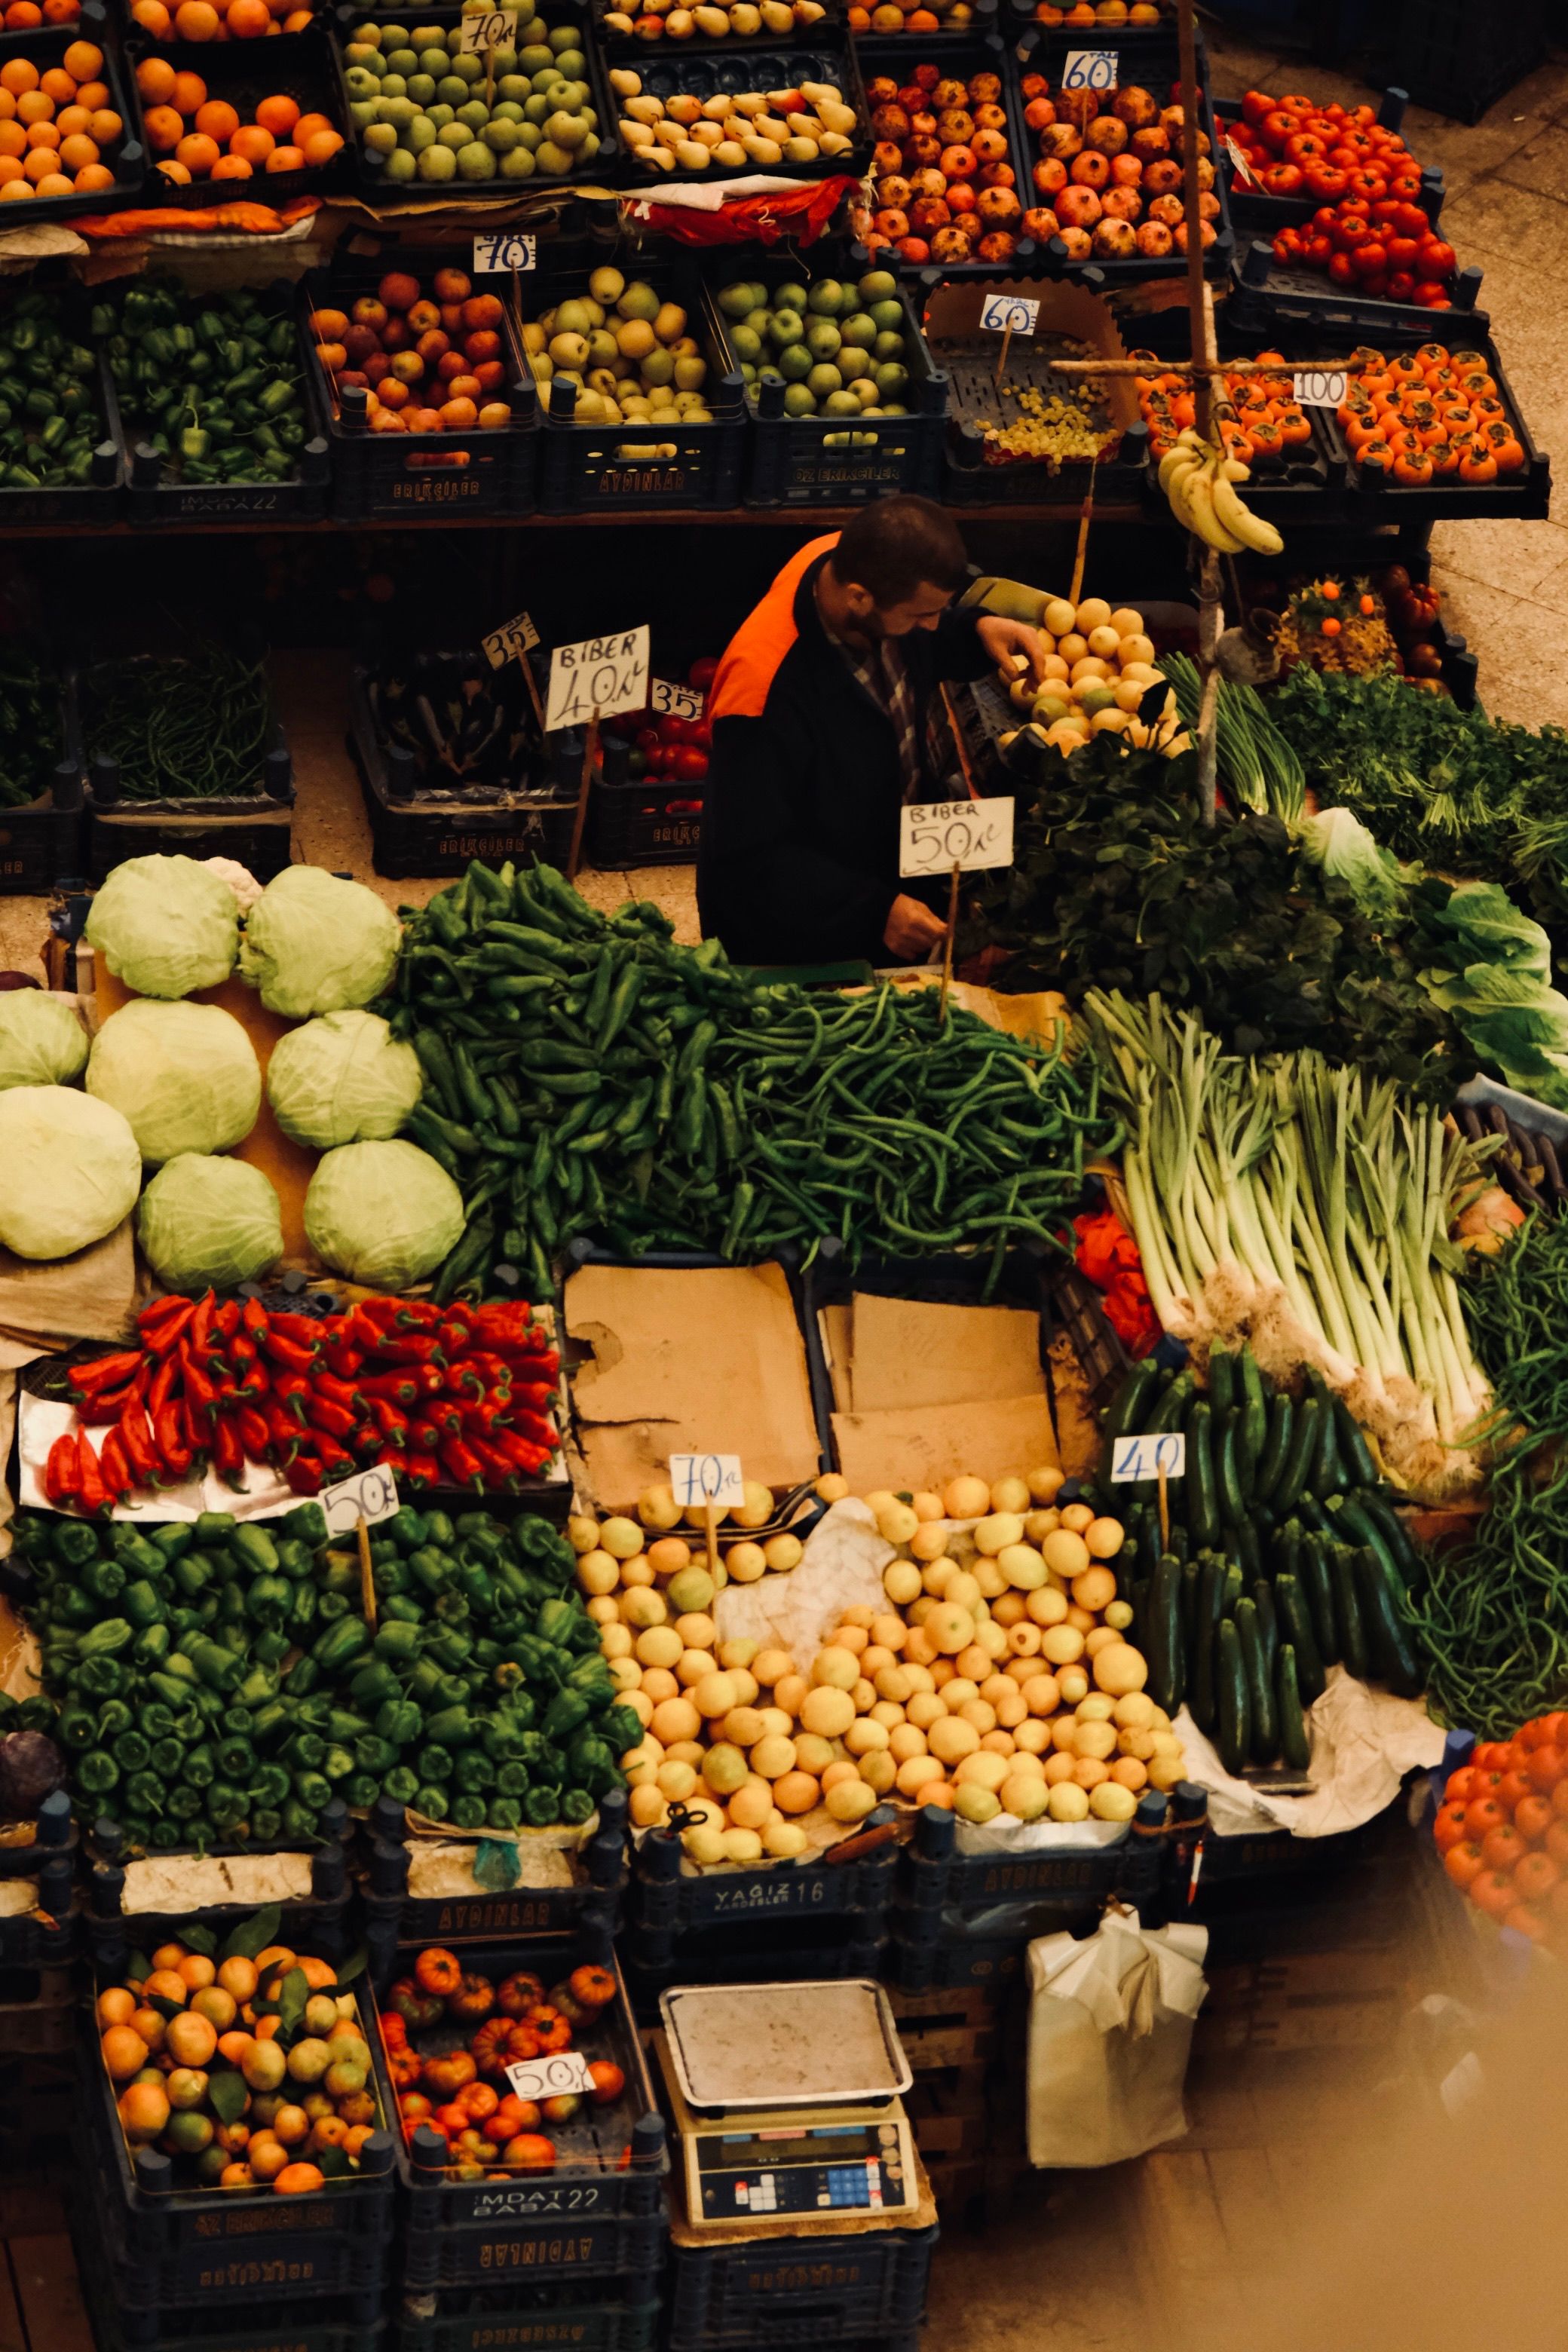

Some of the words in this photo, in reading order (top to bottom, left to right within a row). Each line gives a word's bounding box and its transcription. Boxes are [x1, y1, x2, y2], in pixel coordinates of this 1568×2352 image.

[1066, 54, 1112, 89] 60
[476, 235, 529, 270] 70
[985, 298, 1030, 332] 60
[1296, 372, 1344, 403] 100
[599, 471, 684, 494] AYDINLAR
[657, 684, 697, 719] 35
[1116, 1436, 1179, 1482] 40
[797, 1881, 825, 1903] 16
[437, 1902, 550, 1931] AYDINLAR
[473, 2201, 562, 2217] BABA
[568, 2188, 599, 2209] 22
